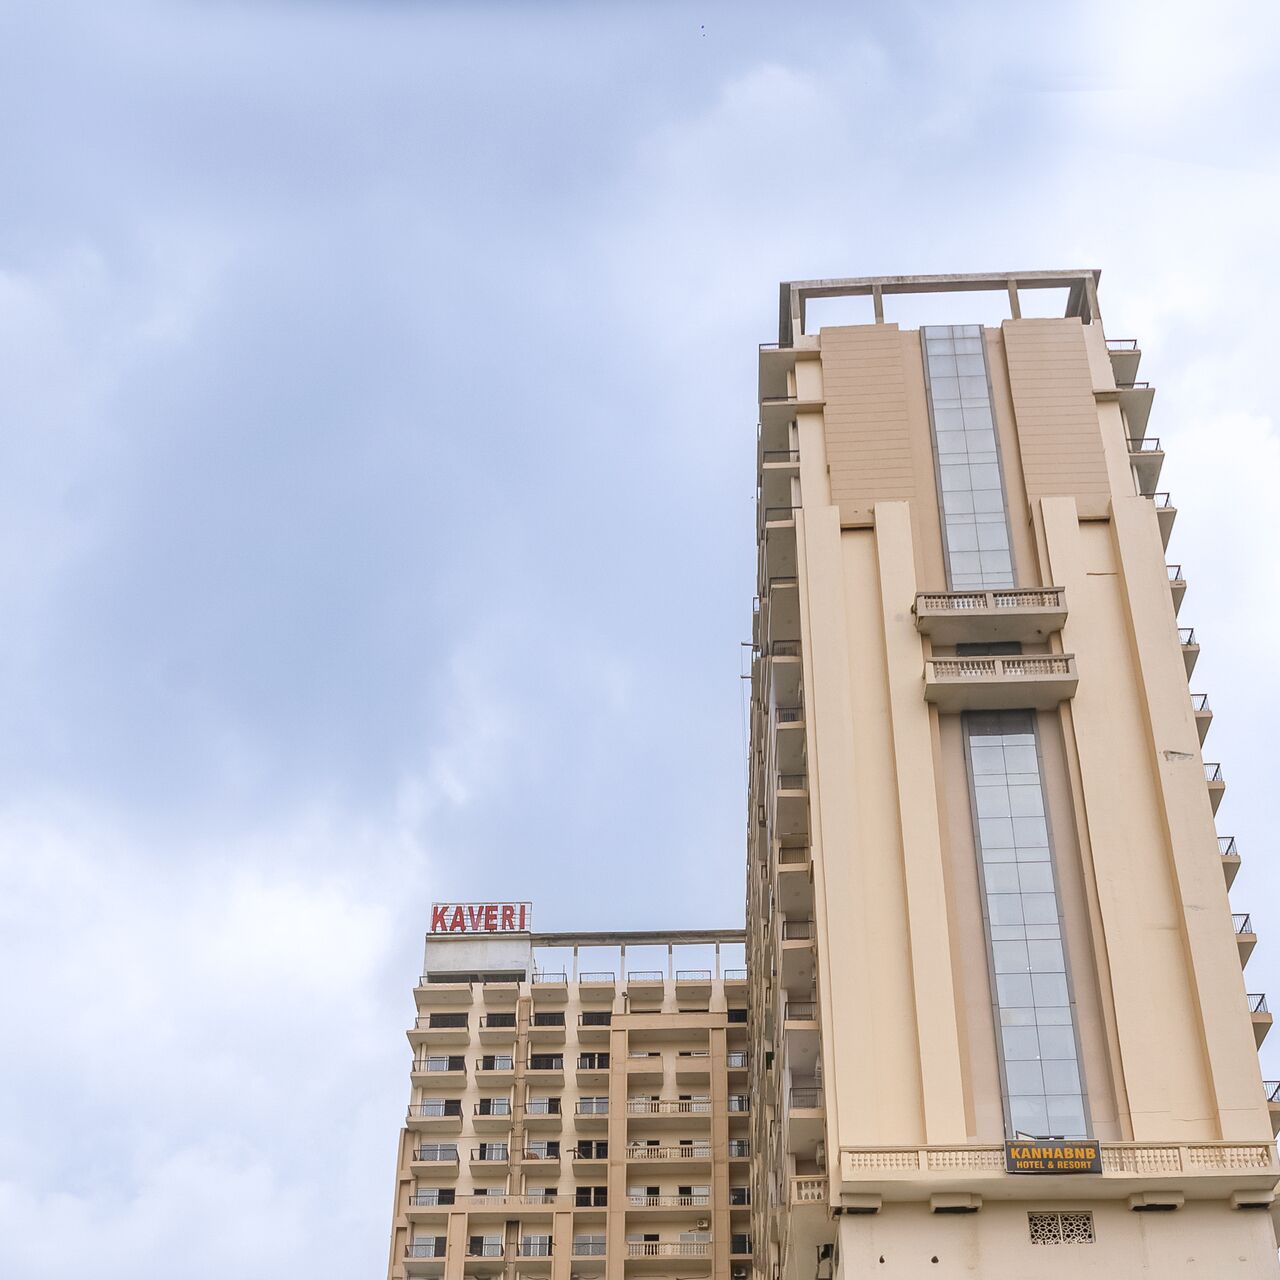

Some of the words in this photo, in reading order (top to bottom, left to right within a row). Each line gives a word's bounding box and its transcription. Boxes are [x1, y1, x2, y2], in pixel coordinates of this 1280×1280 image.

[431, 905, 526, 931] KAVERI
[1010, 1147, 1096, 1159] KANHABNB
[1016, 1161, 1044, 1169] HOTEL
[1047, 1161, 1054, 1169] &
[1057, 1161, 1092, 1169] RESORT
